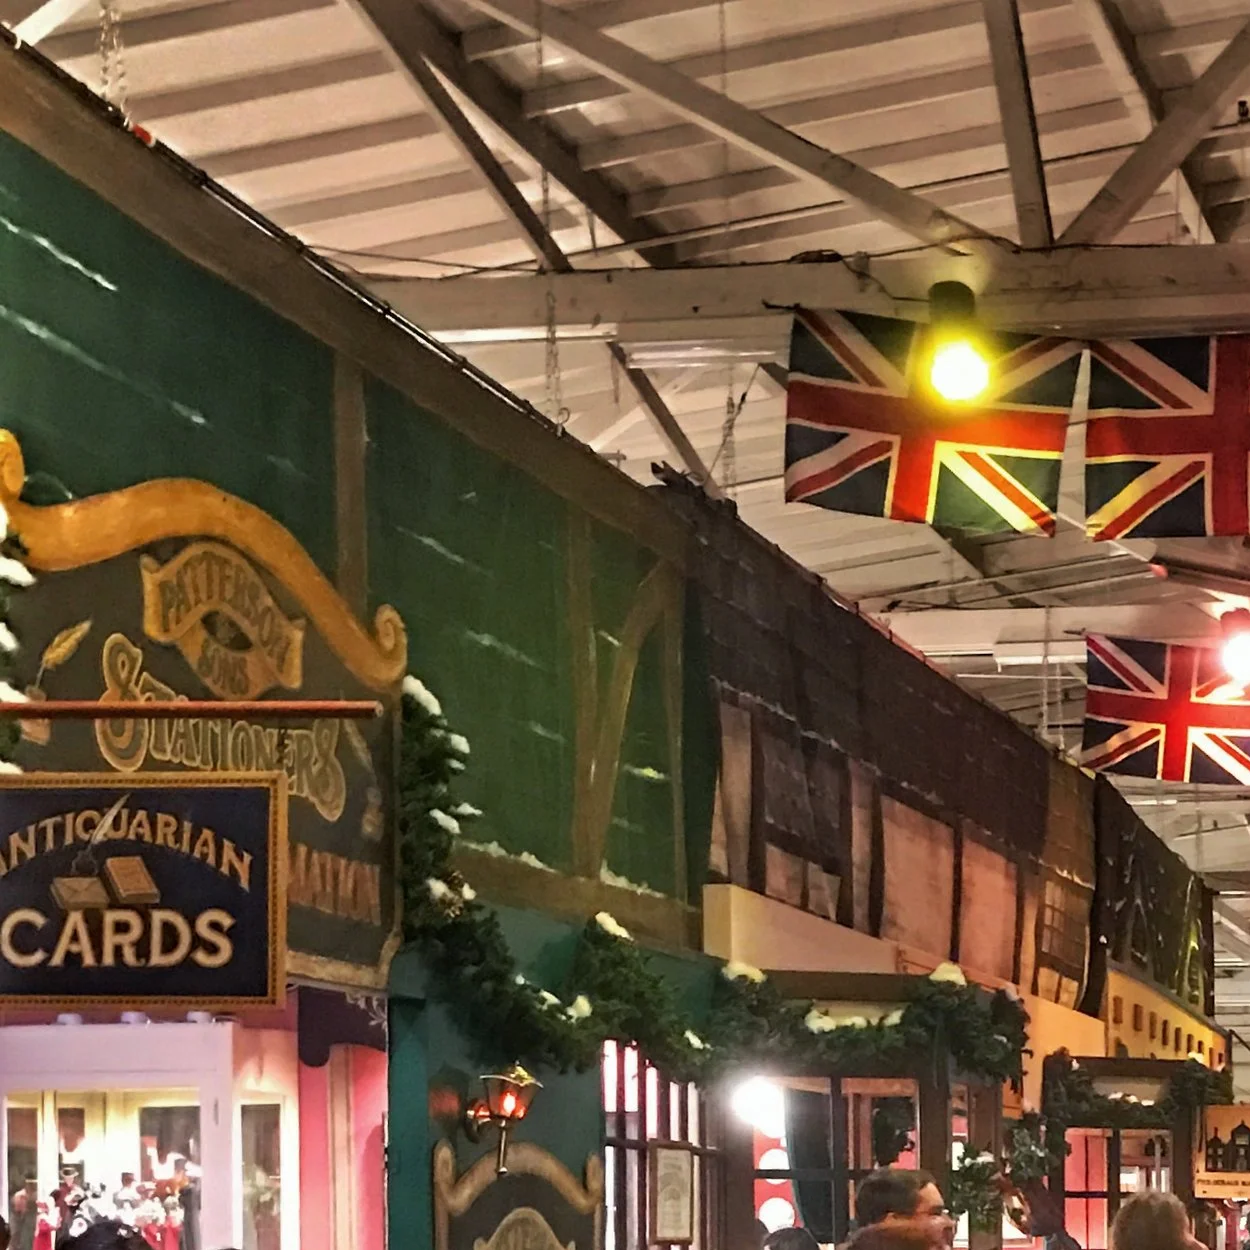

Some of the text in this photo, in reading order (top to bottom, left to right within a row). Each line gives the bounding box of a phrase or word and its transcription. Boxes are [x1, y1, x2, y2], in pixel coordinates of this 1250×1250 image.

[159, 551, 291, 674] PATTERSON
[198, 638, 250, 697] SONS
[95, 632, 346, 822] STATIONERS
[1, 908, 236, 968] CARDS
